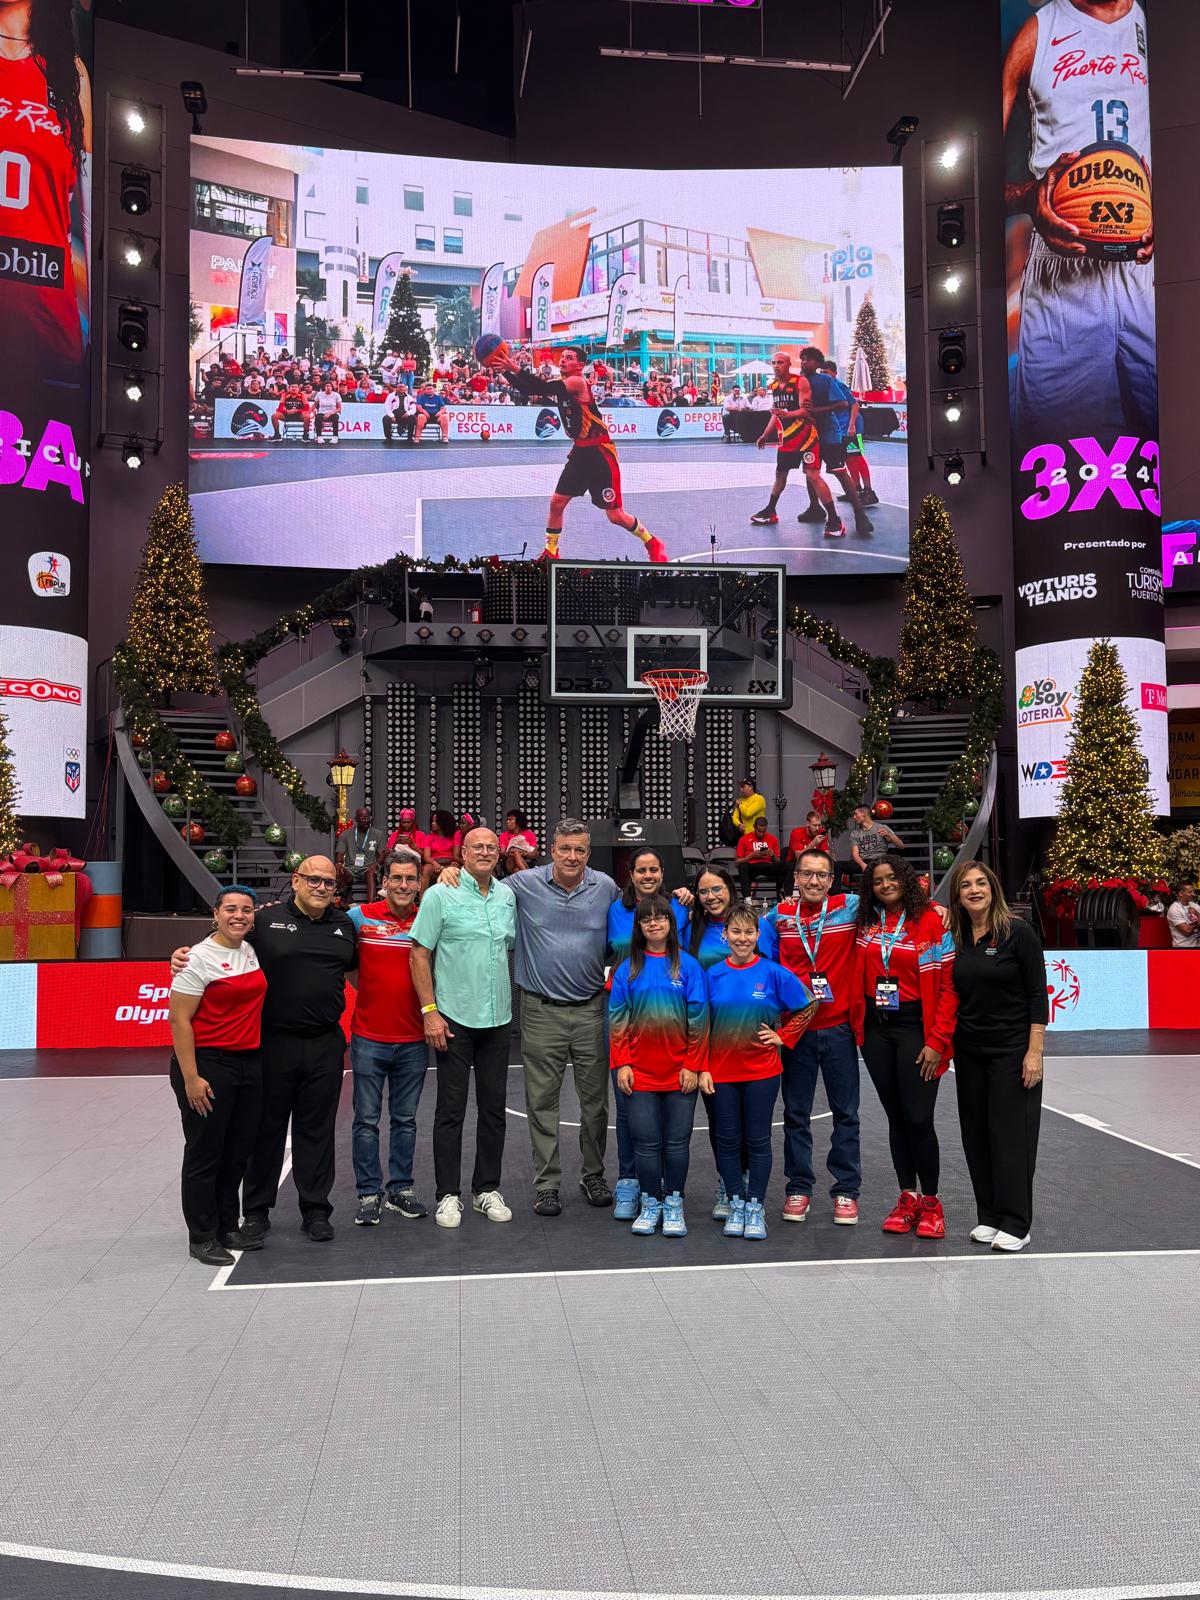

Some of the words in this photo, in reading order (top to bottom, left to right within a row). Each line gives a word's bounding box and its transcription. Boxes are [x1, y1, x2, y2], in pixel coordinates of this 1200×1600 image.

[1052, 49, 1117, 89] Puerto
[15, 100, 64, 136] Rico
[1091, 99, 1129, 144] 13
[1068, 158, 1146, 195] Wilson
[537, 296, 547, 332] DRD
[449, 411, 487, 423] PORTE
[457, 422, 513, 433] ESCOLAR
[684, 412, 722, 423] DEPORT
[1050, 463, 1150, 487] 2024
[1063, 539, 1130, 551] Presentado
[1131, 541, 1147, 550] por
[1026, 586, 1098, 608] TEANDO
[1034, 691, 1068, 707] Soy
